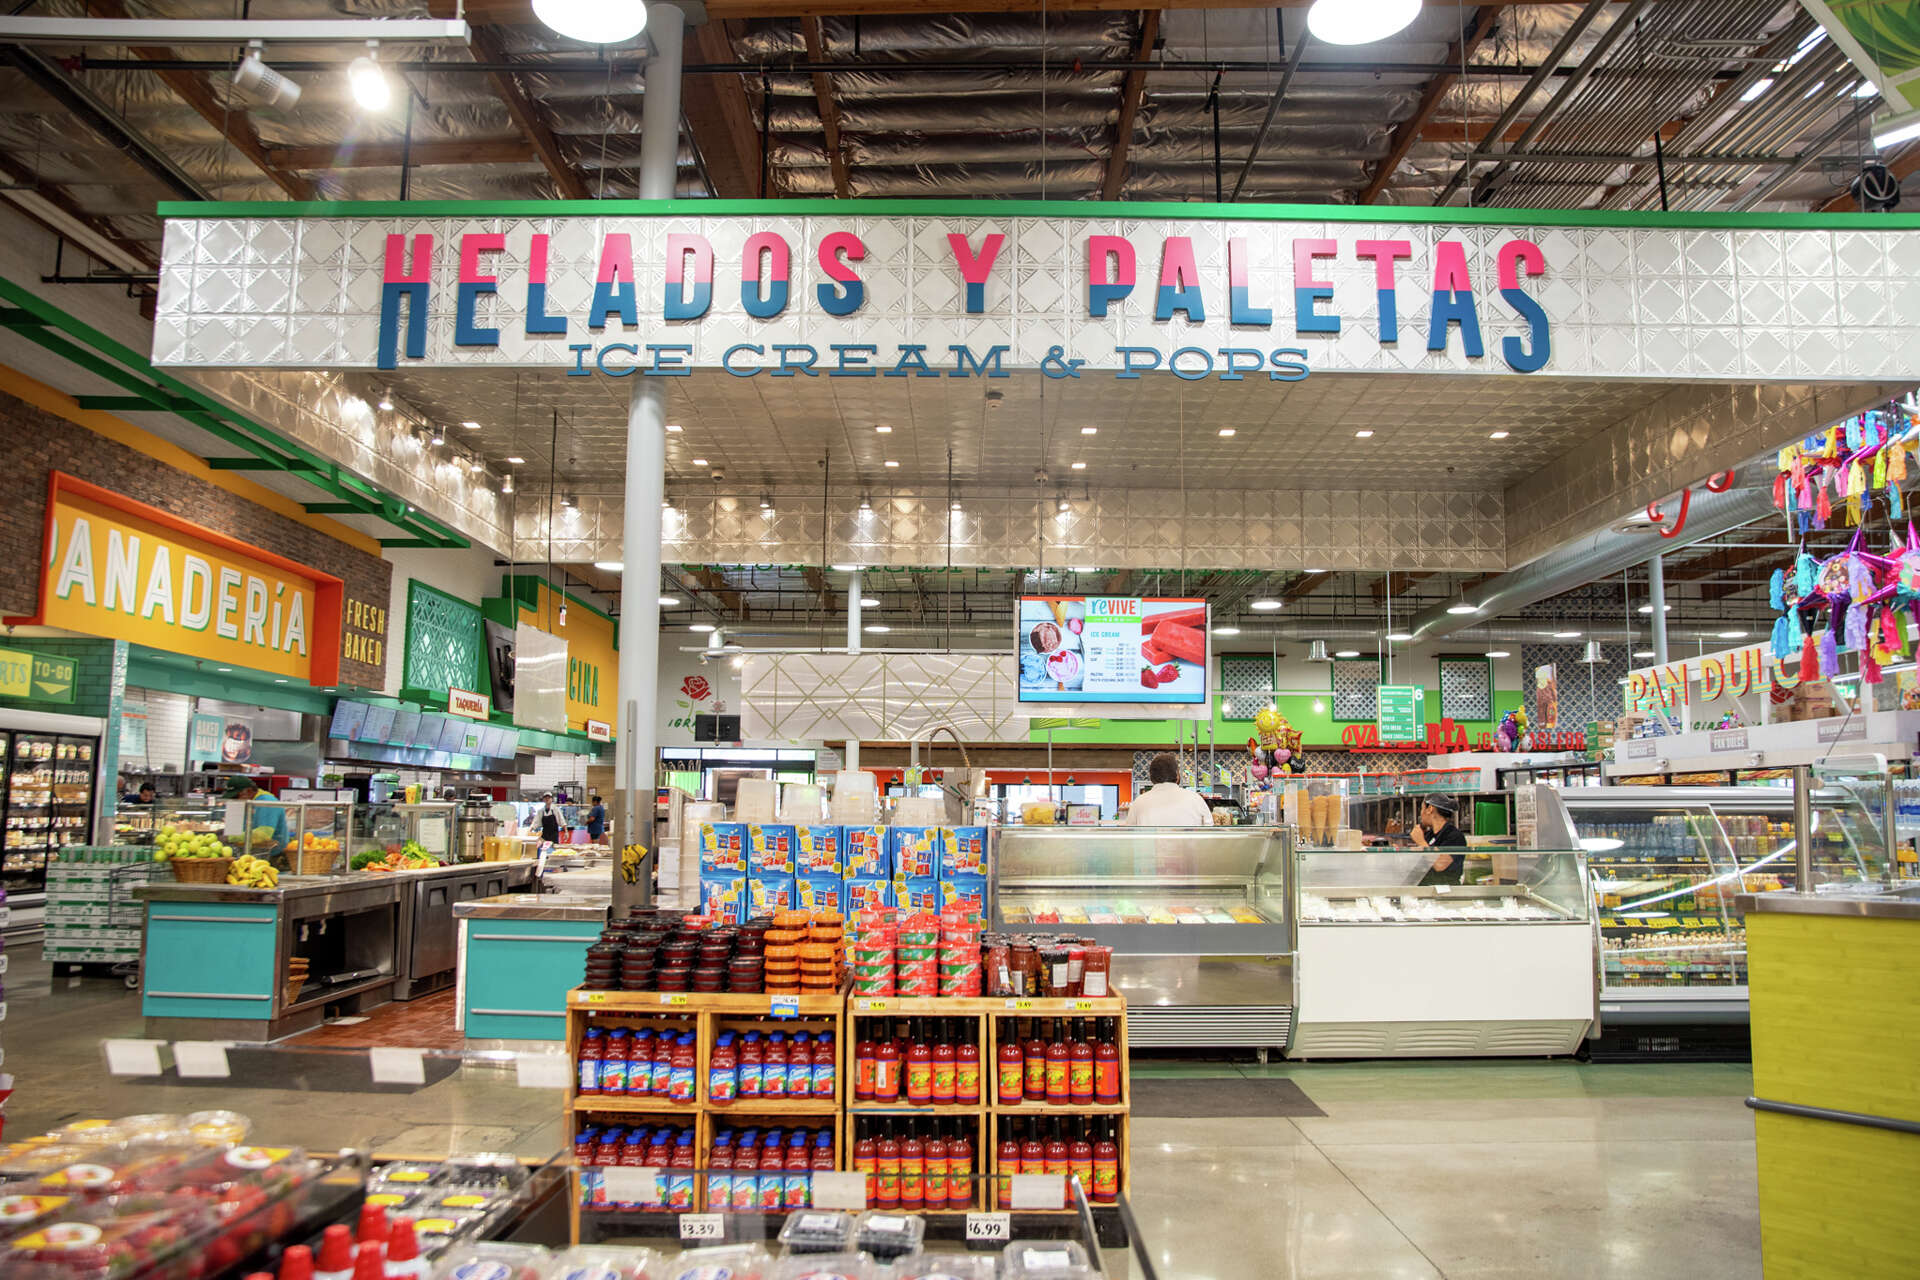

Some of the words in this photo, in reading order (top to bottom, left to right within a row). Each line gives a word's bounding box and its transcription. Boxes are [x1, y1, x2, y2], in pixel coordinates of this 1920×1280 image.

[377, 230, 866, 370] HELADOS
[946, 232, 1006, 314] Y
[1088, 234, 1551, 373] PALETAS
[566, 343, 693, 377] ICE
[722, 343, 1011, 379] CREAM
[1040, 344, 1085, 379] &
[1115, 346, 1310, 382] POPS
[346, 598, 385, 635] FRESH
[344, 631, 383, 667] BAKED
[34, 660, 73, 682] TO-GO
[569, 655, 600, 708] CINA
[1628, 663, 1690, 713] PAN
[1699, 630, 1829, 704] DULC
[1557, 731, 1585, 752] FOR
[682, 1223, 715, 1235] $3.39
[968, 1222, 1001, 1236] $6.99
